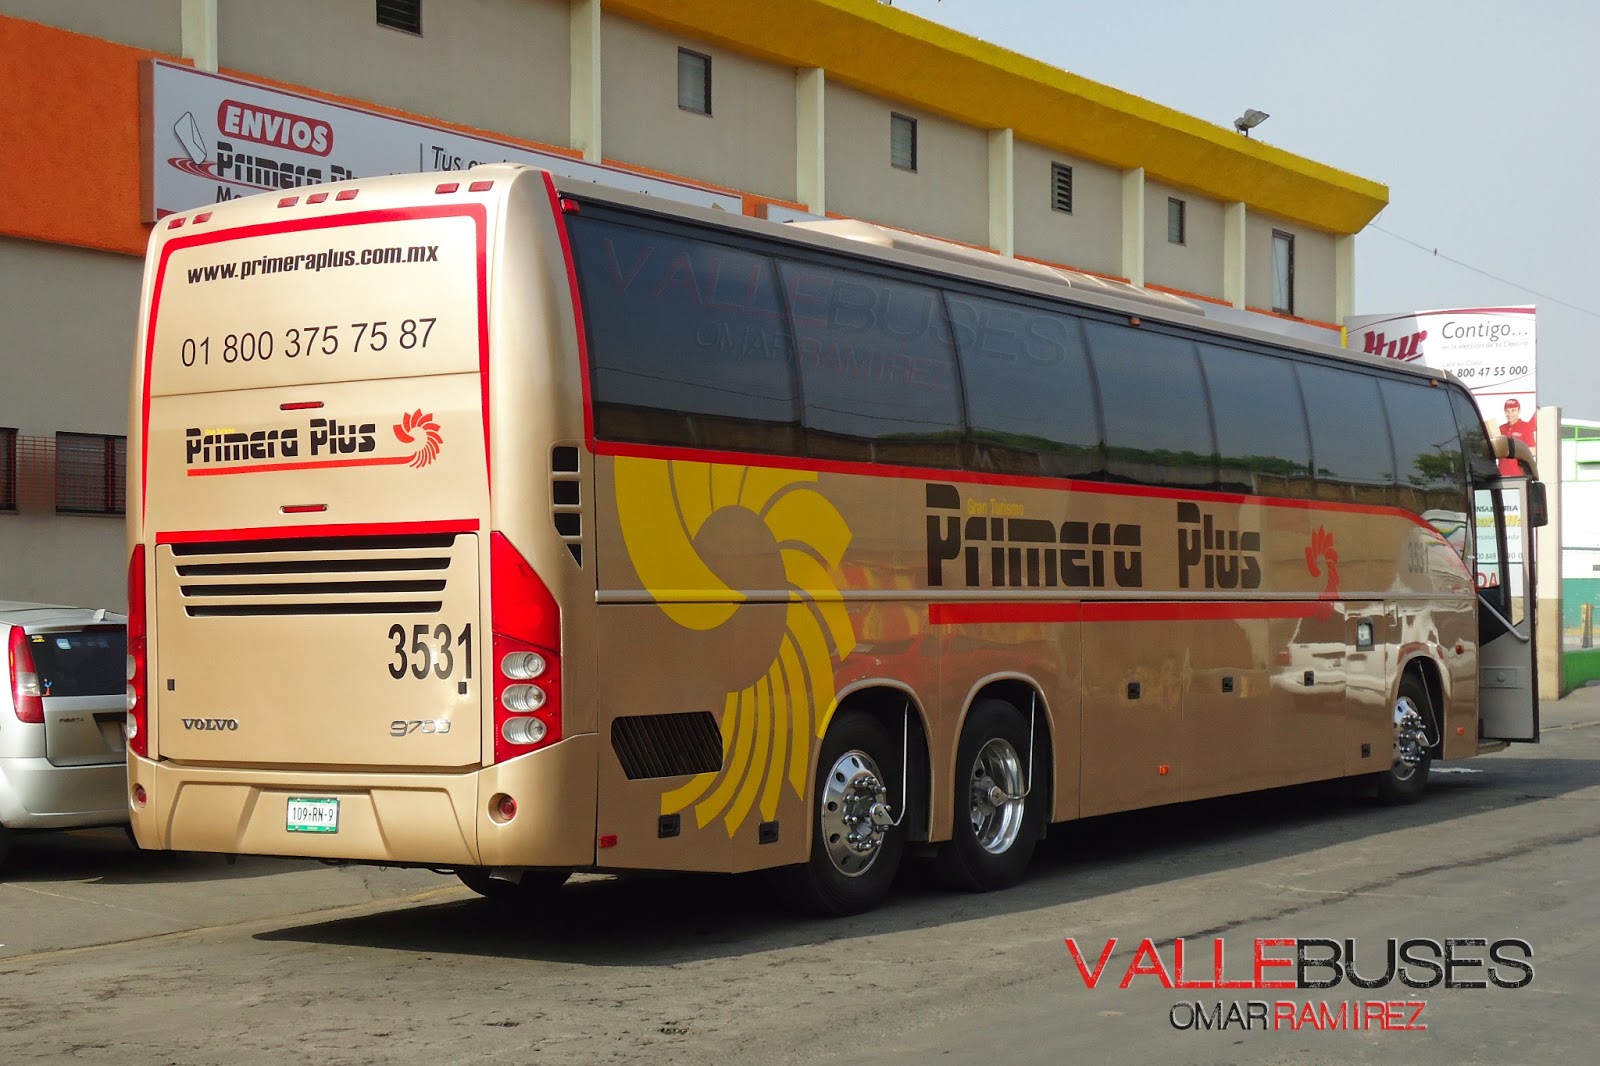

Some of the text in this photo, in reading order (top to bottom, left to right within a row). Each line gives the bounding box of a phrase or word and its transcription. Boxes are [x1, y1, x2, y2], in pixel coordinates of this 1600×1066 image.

[223, 105, 329, 153] ENVIOS
[431, 145, 462, 171] Tus
[187, 245, 439, 284] www.primeraplus.com.mx
[181, 317, 437, 367] 01 800 375 75 87
[1441, 321, 1528, 342] Contigo...
[1457, 368, 1476, 378] 800
[1478, 367, 1490, 377] 47
[1494, 366, 1506, 376] 55
[1509, 365, 1528, 376] 000
[186, 418, 376, 464] Primera Plus
[967, 498, 1025, 517] Gran Turismo
[926, 483, 1262, 589] Primera Plus
[388, 623, 472, 680] 3531
[182, 718, 239, 731] VOLVO
